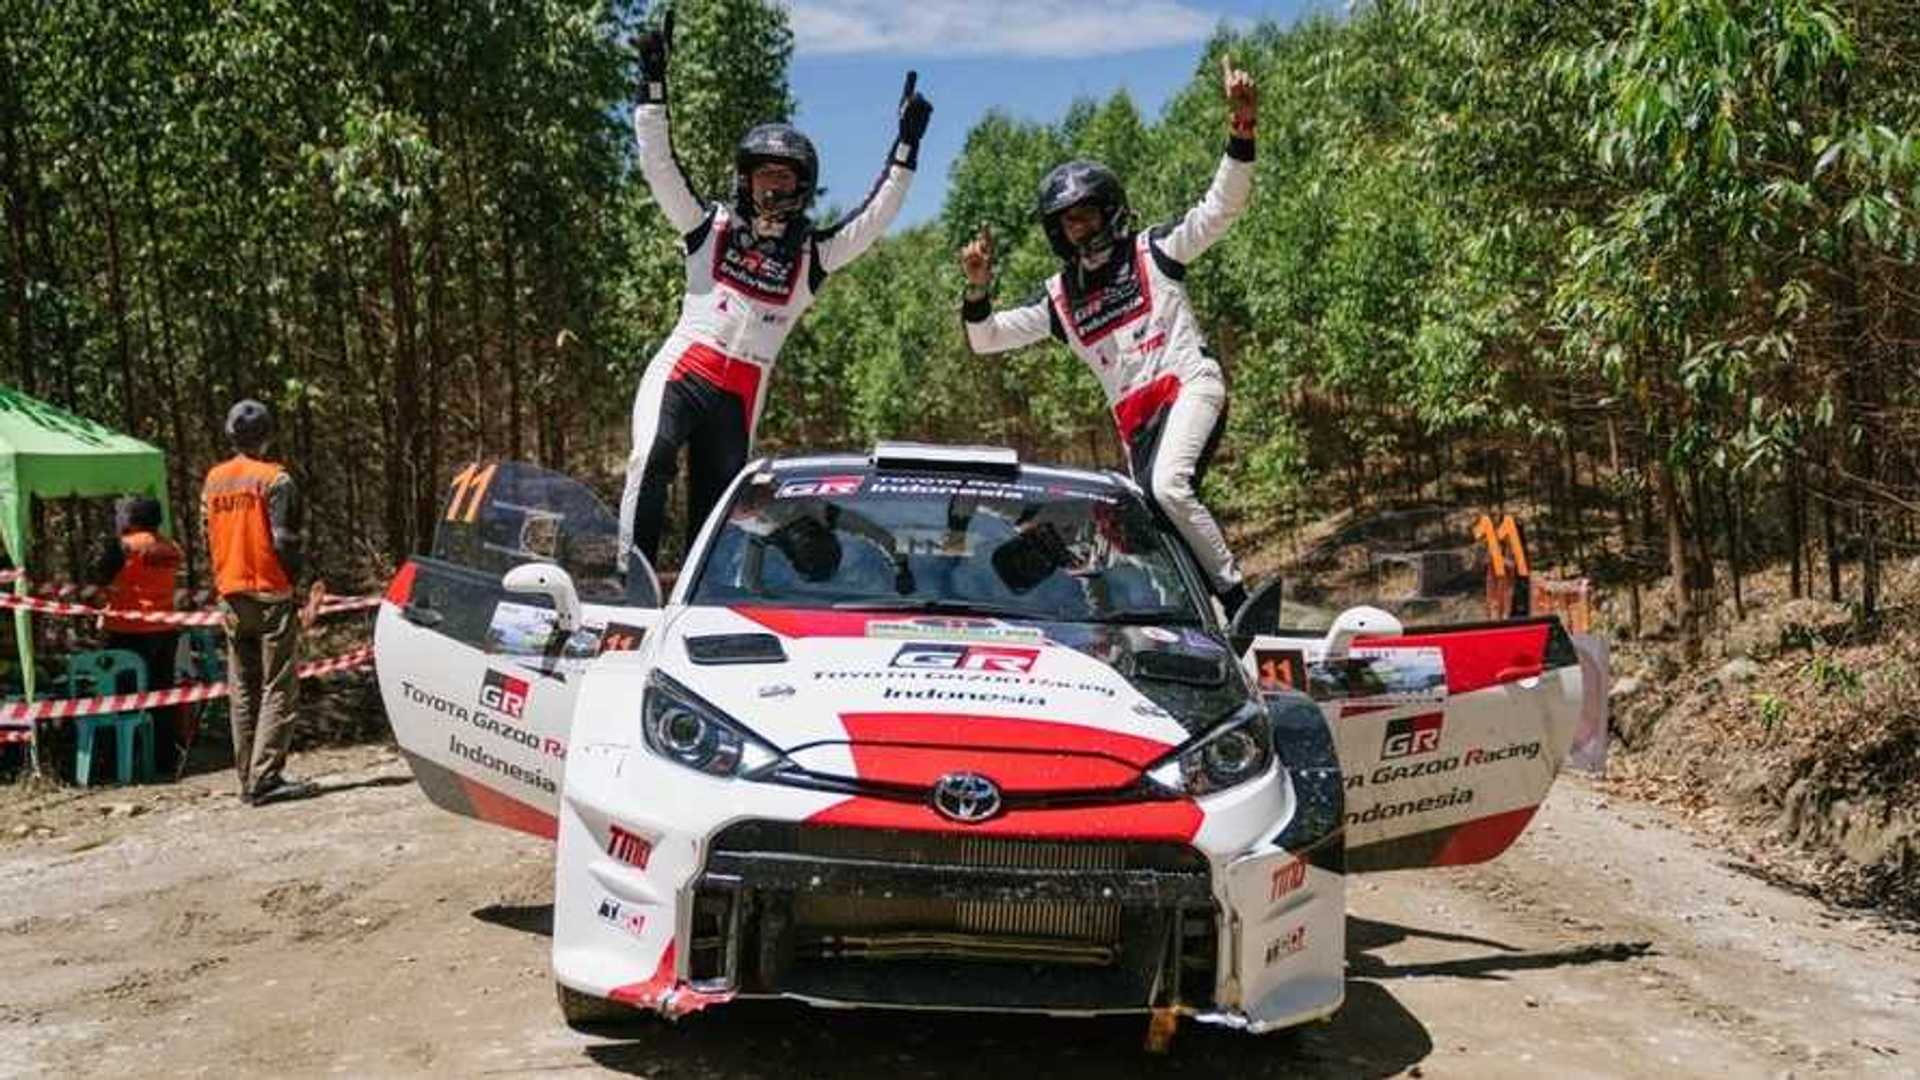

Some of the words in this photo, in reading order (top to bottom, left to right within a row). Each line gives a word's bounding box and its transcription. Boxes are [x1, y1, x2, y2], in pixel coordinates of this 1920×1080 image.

[447, 463, 498, 522] 11
[776, 479, 862, 499] GR
[870, 483, 1023, 499] Indonesia
[1472, 515, 1530, 577] 11
[893, 645, 1037, 672] GR
[1262, 658, 1293, 692] 11
[402, 681, 468, 722] TOYOTA
[473, 711, 540, 750] GAZOO
[480, 678, 527, 720] GR
[883, 687, 1046, 706] Indonesia
[1382, 722, 1440, 760] GR
[449, 734, 557, 794] Indonesia
[1370, 757, 1458, 785] GAZOO
[1463, 740, 1541, 768] Racing
[1344, 787, 1473, 825] ndonesia
